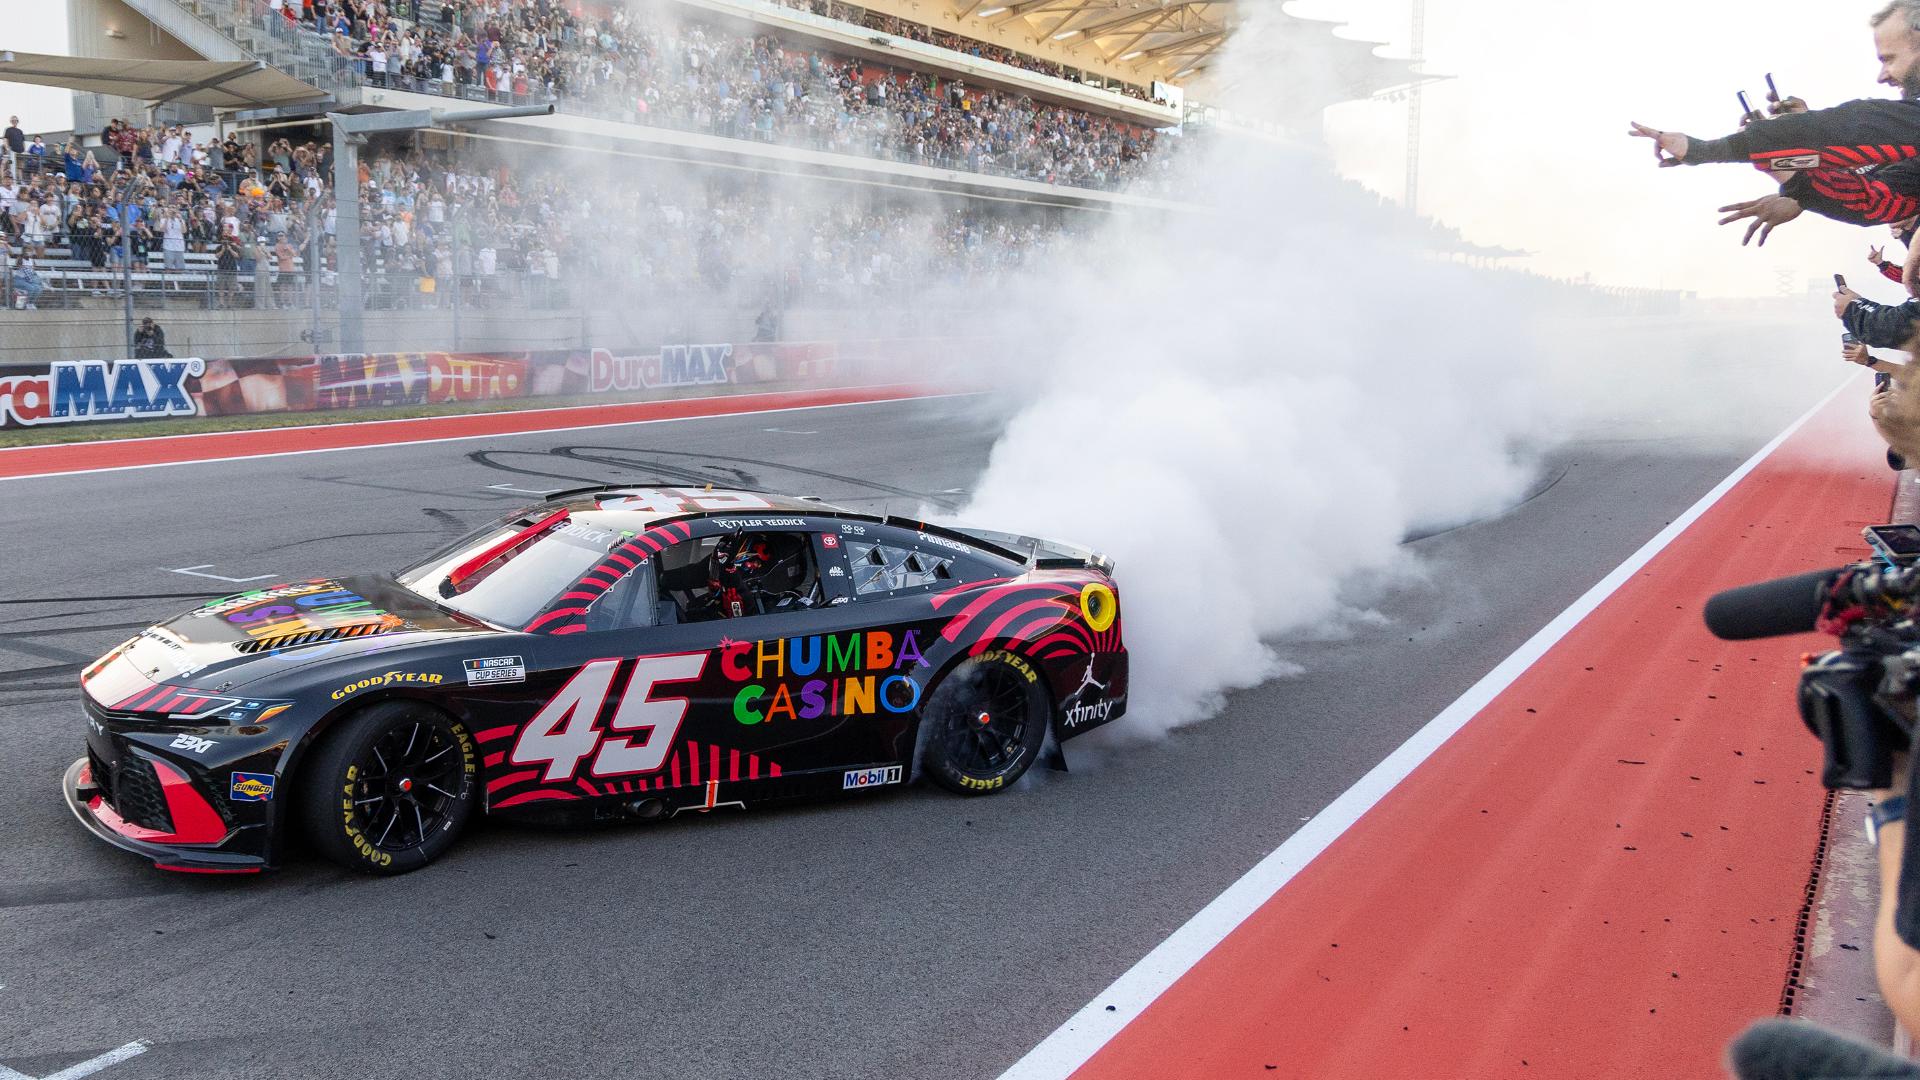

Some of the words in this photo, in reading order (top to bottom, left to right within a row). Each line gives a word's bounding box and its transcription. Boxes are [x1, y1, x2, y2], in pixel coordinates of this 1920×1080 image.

[592, 345, 728, 391] DuraMAX
[731, 519, 763, 527] TYLER
[762, 518, 806, 526] REDDICK
[483, 658, 514, 668] NASCAR
[720, 629, 931, 682] CHUMBA
[331, 673, 444, 700] GOODYEAR
[475, 671, 491, 680] CUP
[491, 669, 518, 679] SERIES
[733, 675, 921, 725] CASINO
[1064, 698, 1113, 728] xfinity
[511, 650, 711, 783] 45
[451, 723, 476, 773] EAGLE
[234, 783, 271, 793] SUNOCO
[845, 769, 885, 787] Mobil
[960, 774, 1004, 790] EAGLE
[343, 765, 392, 866] GOODYEAR
